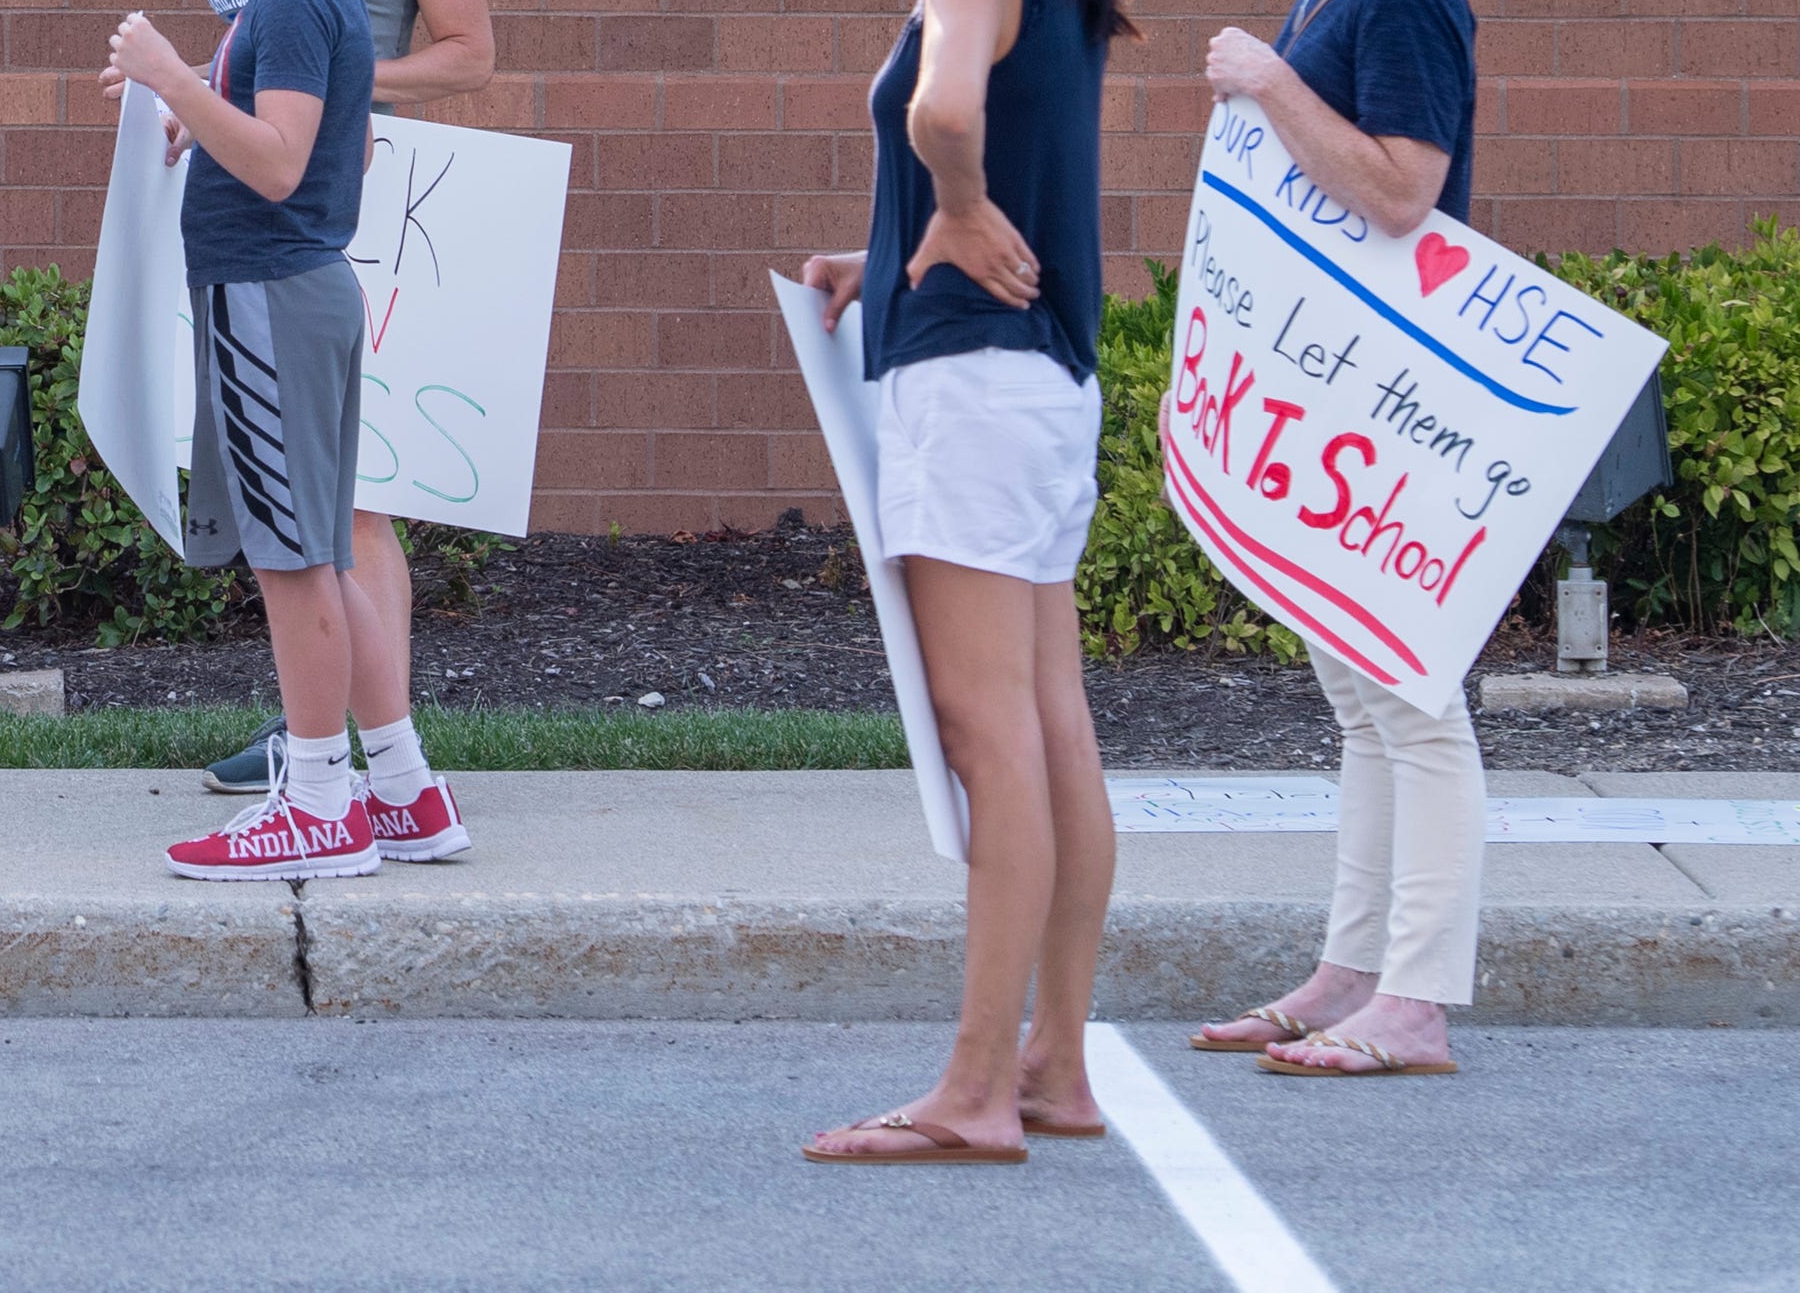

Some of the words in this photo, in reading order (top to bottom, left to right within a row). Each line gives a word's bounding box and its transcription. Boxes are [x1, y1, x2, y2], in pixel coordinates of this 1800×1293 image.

[1191, 209, 1254, 329] Please
[1273, 296, 1360, 385] Let
[1369, 367, 1475, 473] them
[1454, 459, 1533, 521] go
[1457, 263, 1605, 386] HSE
[1297, 432, 1487, 608] School
[227, 821, 354, 858] INDIANA
